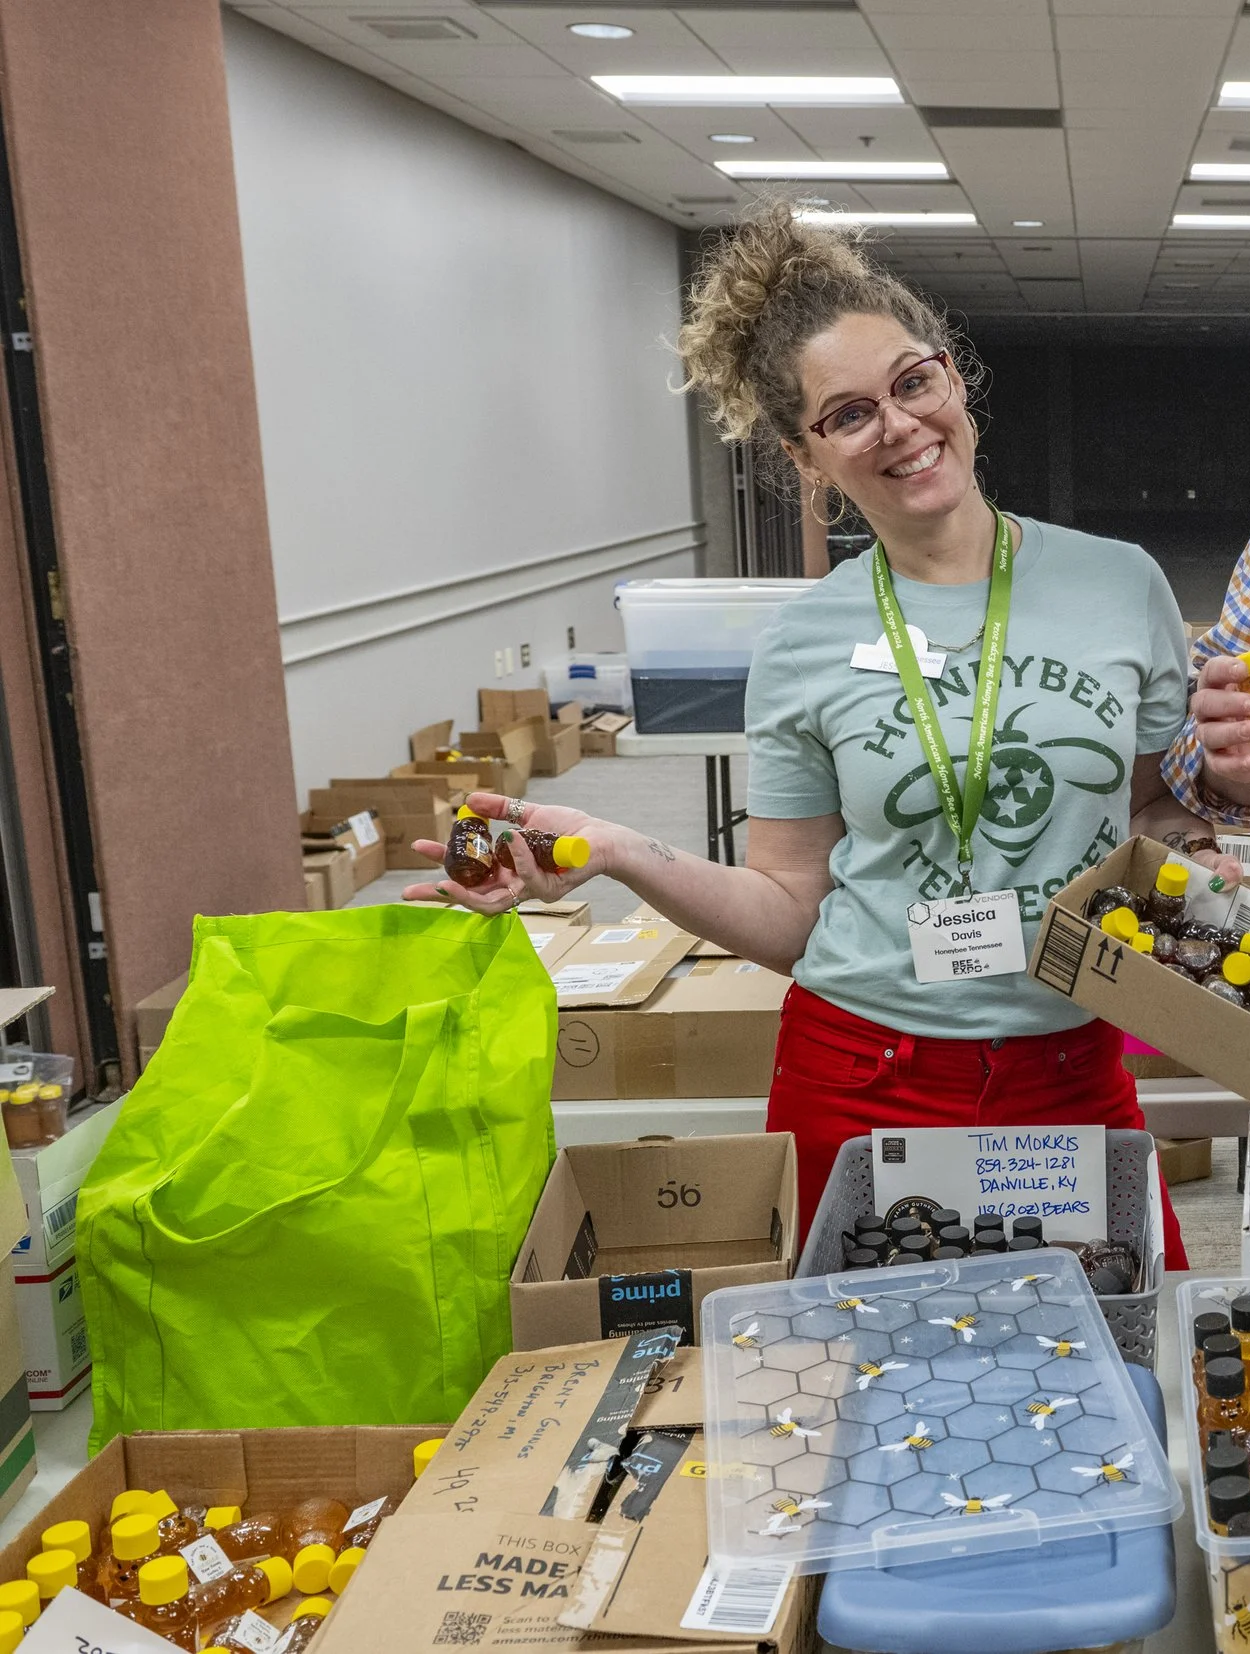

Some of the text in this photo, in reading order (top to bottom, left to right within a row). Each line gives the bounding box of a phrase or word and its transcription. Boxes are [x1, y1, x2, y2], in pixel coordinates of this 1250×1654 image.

[863, 655, 1124, 759] HONYBEE
[973, 622, 1002, 780] North American Honey Bee Expo 2024
[914, 697, 928, 722] North
[922, 721, 942, 764] American
[936, 763, 951, 795] Honey
[973, 892, 1015, 904] VENDOR
[933, 909, 996, 929] Jessica
[951, 930, 982, 942] Davis
[934, 942, 1003, 956] Honeybee Tennessee
[951, 959, 973, 968] BEE
[952, 966, 983, 976] EXPO
[968, 1133, 1079, 1152] TIM MORRIS
[975, 1156, 1075, 1175] 859-324-1281
[1058, 1175, 1077, 1193] KY
[657, 1180, 702, 1209] 56
[1042, 1200, 1090, 1217] BEARS
[611, 1278, 681, 1304] prime
[553, 1359, 600, 1408] BRENT
[496, 1534, 582, 1556] THIS BOX
[474, 1552, 569, 1579] MADE
[436, 1574, 513, 1595] LESS
[503, 1616, 532, 1624] Scan
